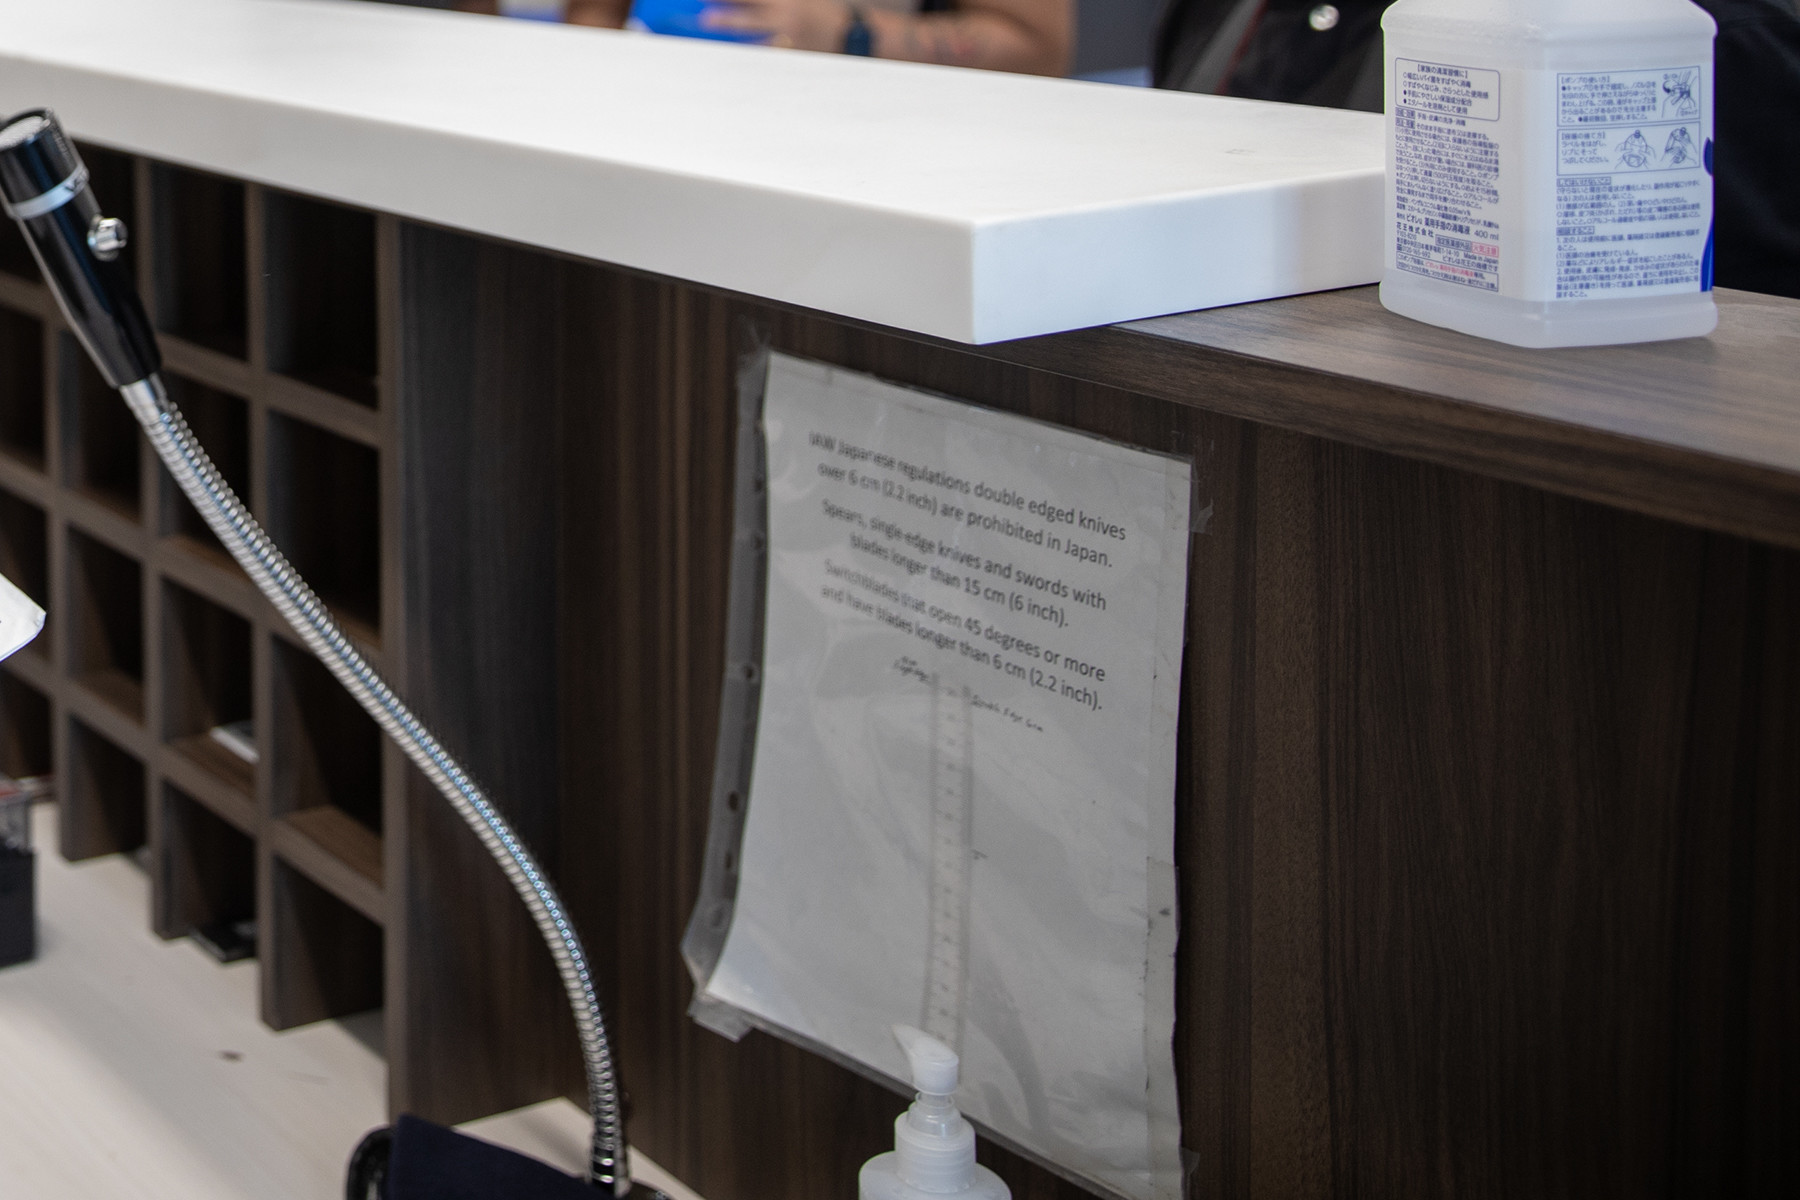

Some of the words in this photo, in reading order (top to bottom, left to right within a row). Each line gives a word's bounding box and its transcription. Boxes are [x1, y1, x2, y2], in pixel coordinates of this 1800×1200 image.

[1397, 221, 1433, 238] 花王株式会社
[1474, 229, 1488, 239] 400
[817, 463, 846, 481] over
[848, 469, 858, 486] 6
[860, 475, 881, 493] cm
[905, 488, 938, 516] inch)
[940, 503, 964, 522] are
[967, 510, 1044, 546] prohibited
[1047, 532, 1061, 551] in
[1064, 539, 1113, 568] Japan.
[897, 460, 971, 495] regulations
[974, 482, 1025, 510] double
[1028, 500, 1075, 524] edged
[1079, 511, 1126, 541] knives
[822, 498, 867, 529] Spears,
[938, 540, 981, 570] knives
[984, 559, 1012, 579] and
[1015, 569, 1069, 598] swords
[1072, 588, 1106, 611] with
[851, 532, 889, 561] blades
[890, 548, 928, 576] longer
[930, 565, 961, 588] than
[964, 576, 981, 596] 15
[983, 586, 1006, 605] cm
[1008, 592, 1024, 612] (6
[1027, 598, 1069, 628] inch).
[875, 605, 913, 634] blades
[915, 620, 957, 650] longer
[959, 640, 990, 666] than
[993, 653, 1002, 670] 6
[1004, 661, 1026, 680] cm
[1029, 666, 1057, 693] (2.2
[1061, 679, 1103, 711] inch).
[928, 605, 962, 628] open
[964, 616, 982, 636] 45
[984, 625, 1040, 659] degrees
[1044, 649, 1060, 665] or
[1064, 657, 1106, 682] more
